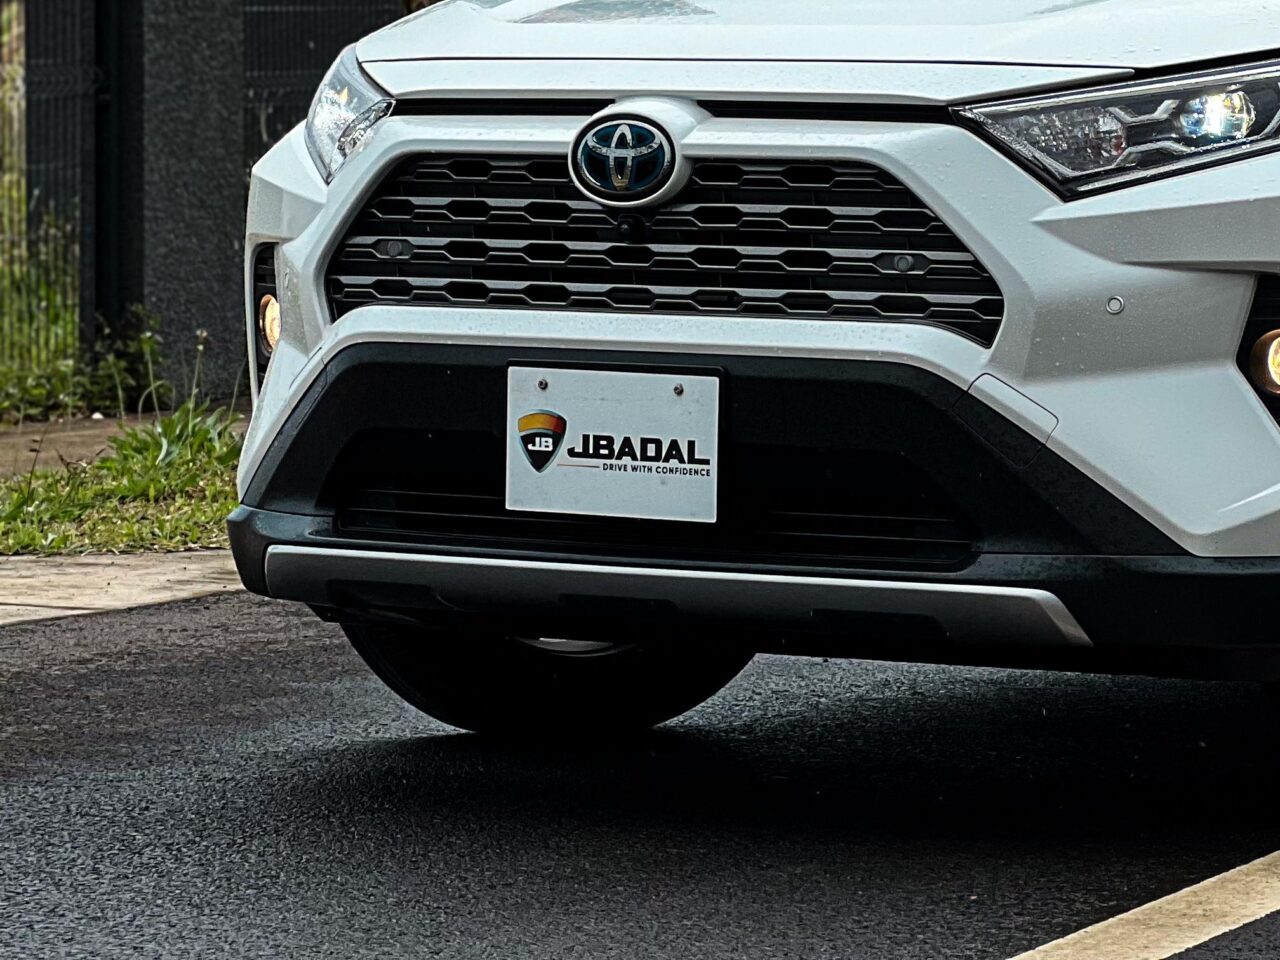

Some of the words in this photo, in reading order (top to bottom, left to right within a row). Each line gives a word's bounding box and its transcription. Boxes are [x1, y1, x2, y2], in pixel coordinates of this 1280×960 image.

[527, 437, 553, 452] JB
[567, 434, 711, 465] JBADAL
[602, 463, 628, 473] DRIVE
[631, 465, 653, 474] WITH
[655, 466, 711, 477] CONFIDENCE
